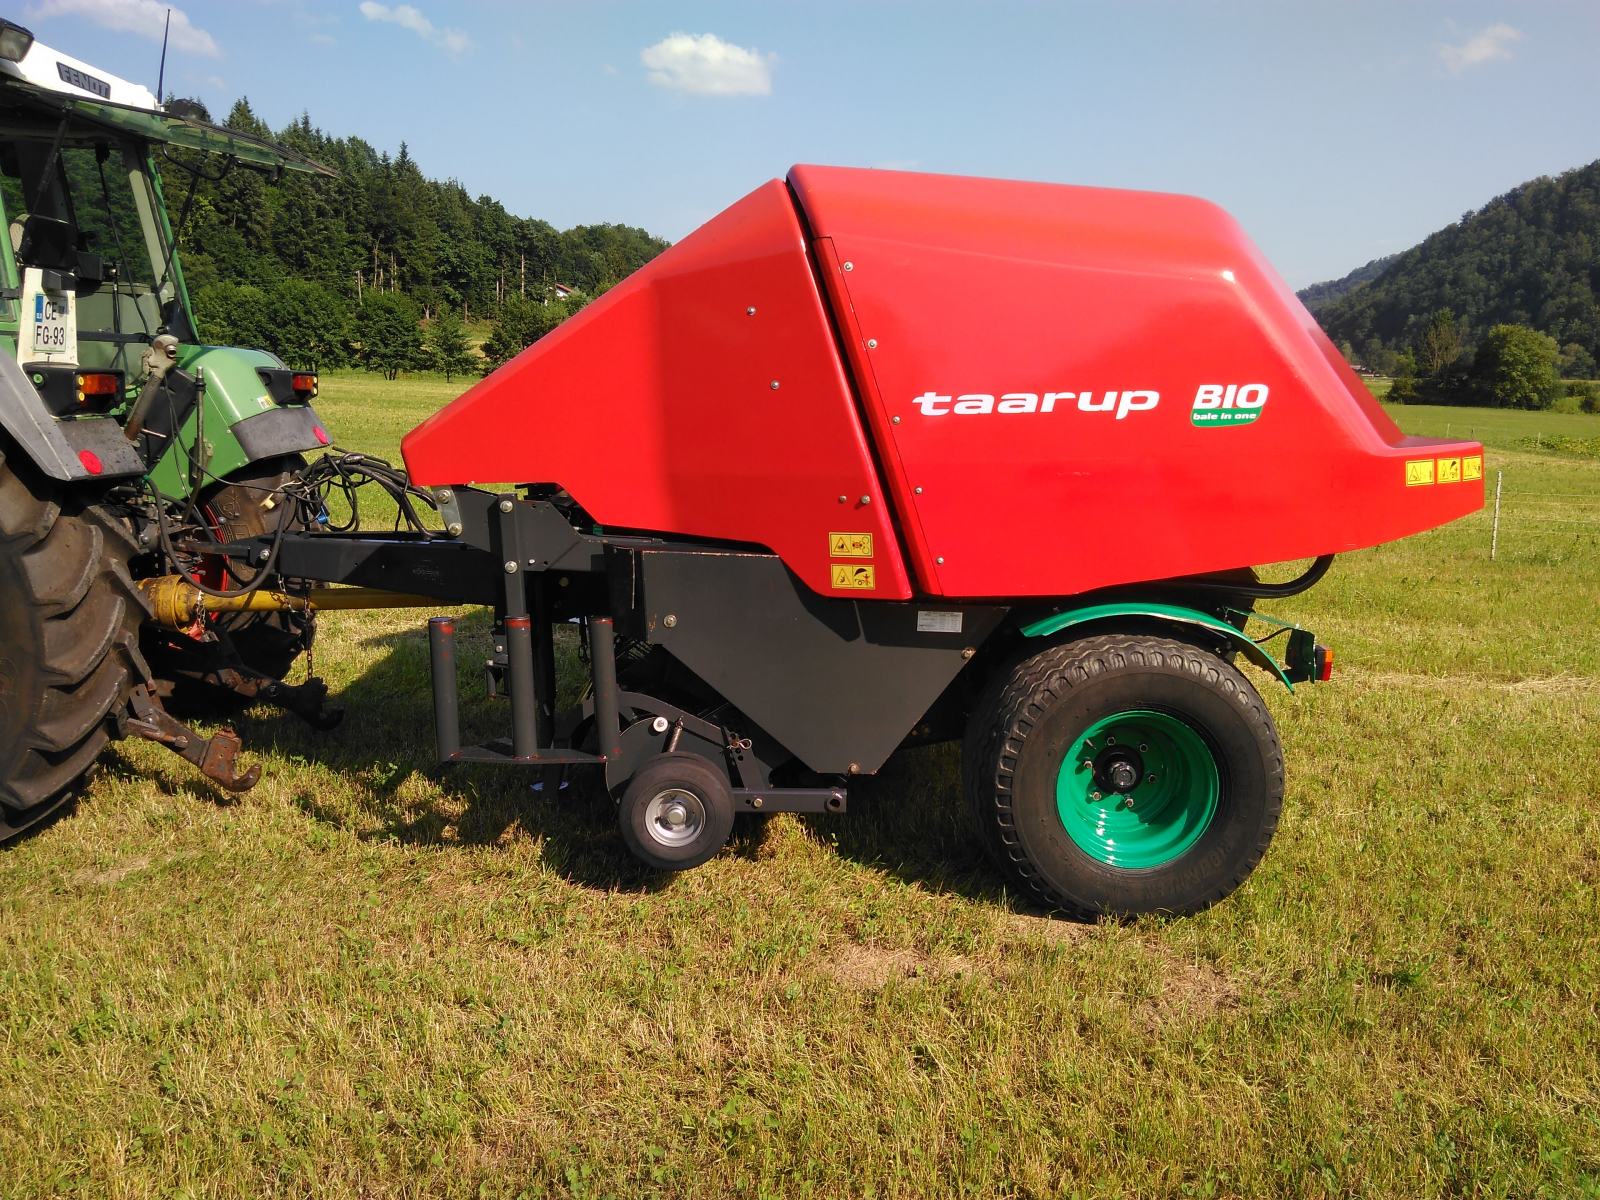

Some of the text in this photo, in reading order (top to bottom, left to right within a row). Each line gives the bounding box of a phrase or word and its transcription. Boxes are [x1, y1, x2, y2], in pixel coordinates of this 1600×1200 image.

[60, 64, 109, 97] FENDT
[45, 302, 58, 320] CE
[36, 325, 65, 345] FG-93
[912, 390, 1160, 420] taarup
[1193, 384, 1269, 409] BIO
